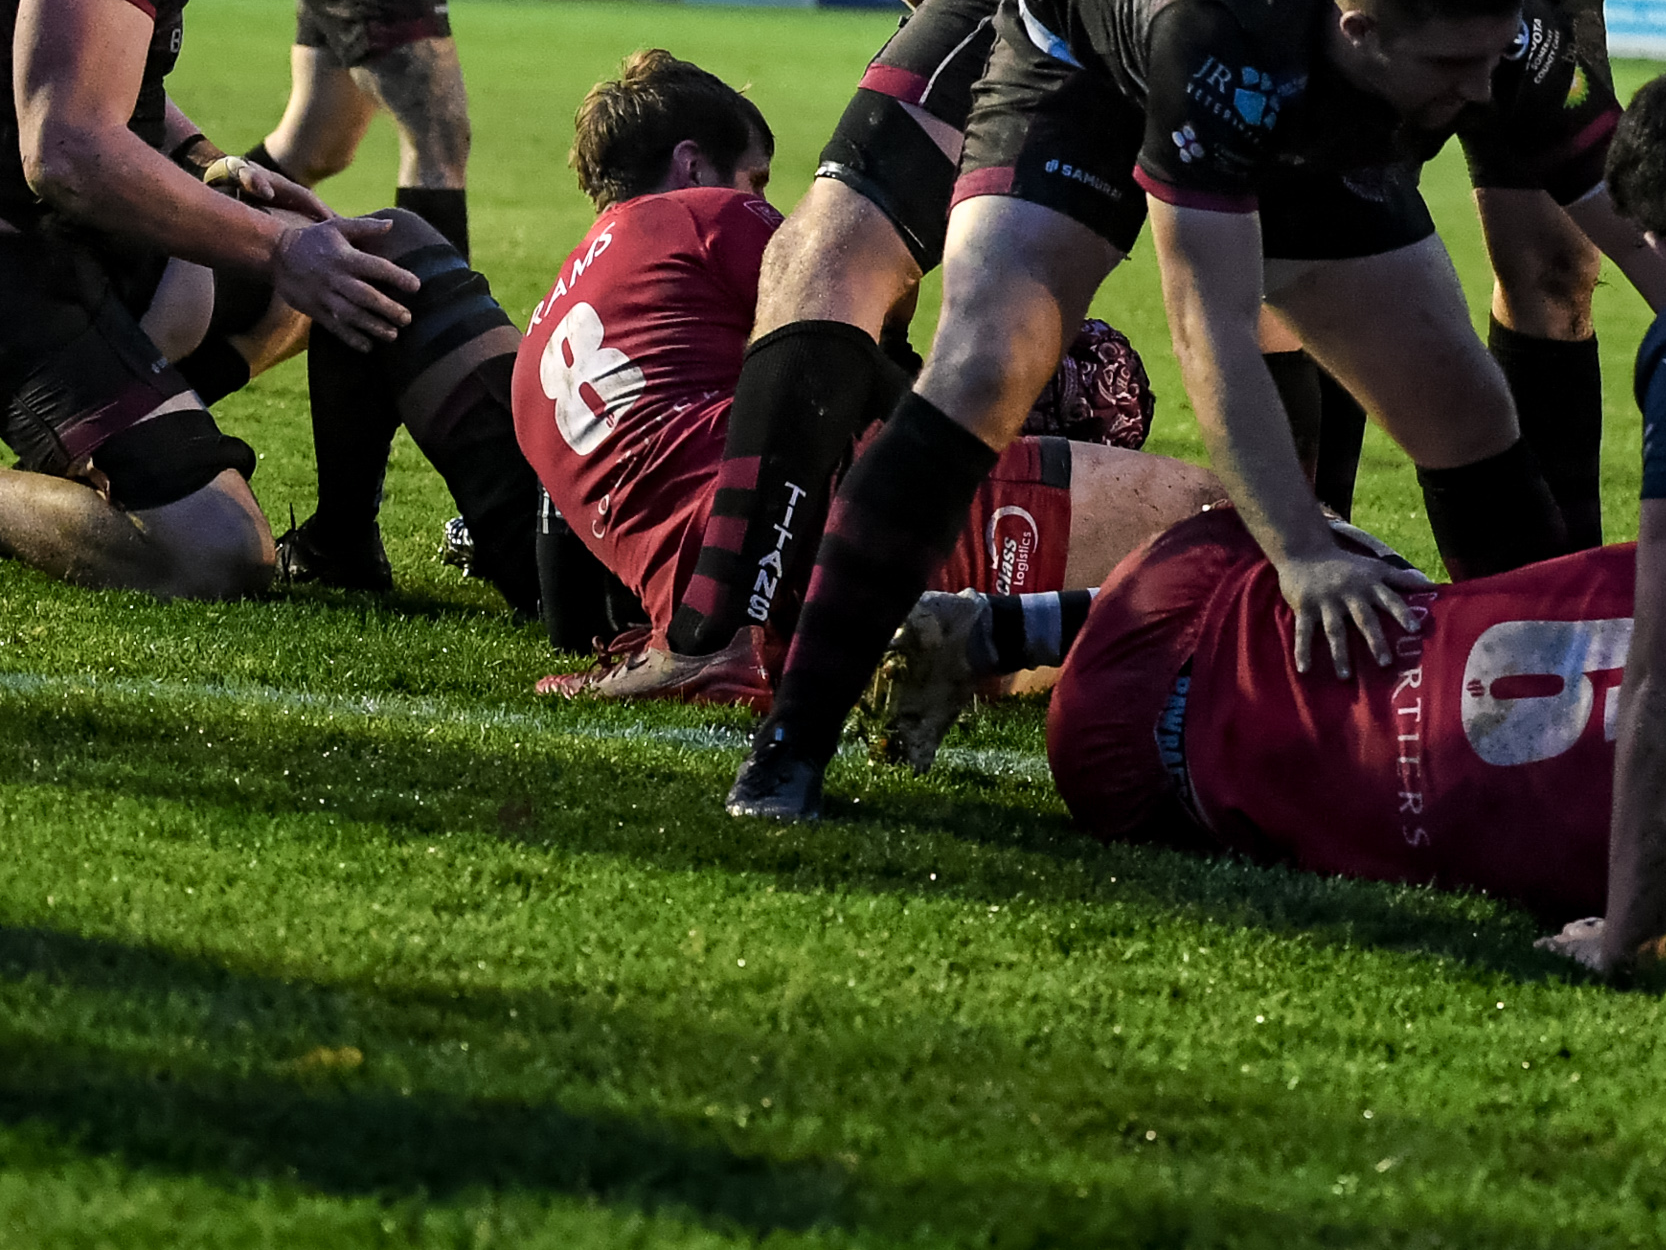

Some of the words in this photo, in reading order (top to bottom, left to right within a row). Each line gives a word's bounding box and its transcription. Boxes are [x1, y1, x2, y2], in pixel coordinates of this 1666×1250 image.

[1193, 55, 1232, 95] JR
[526, 221, 616, 337] RAMS
[539, 301, 648, 456] 8
[747, 481, 807, 622] TITANS
[1013, 531, 1032, 586] Logistics
[1461, 617, 1635, 767] 6
